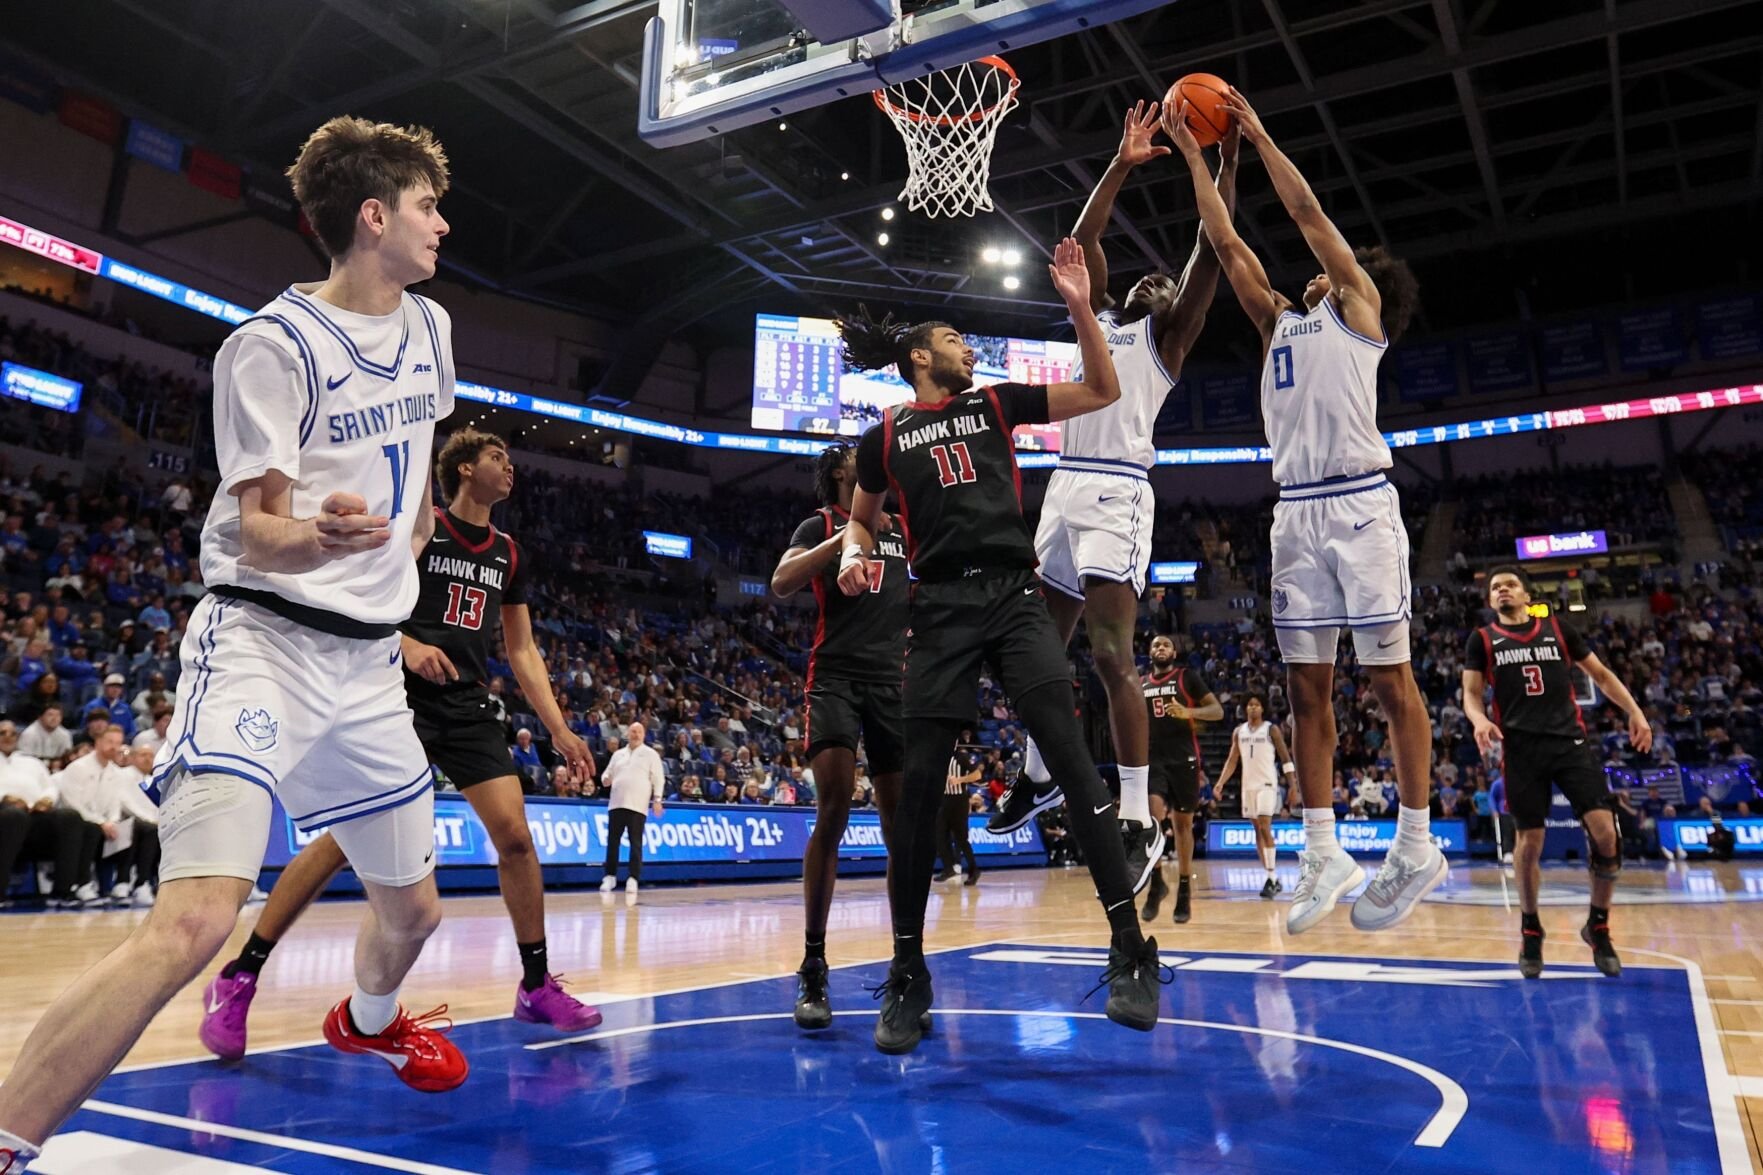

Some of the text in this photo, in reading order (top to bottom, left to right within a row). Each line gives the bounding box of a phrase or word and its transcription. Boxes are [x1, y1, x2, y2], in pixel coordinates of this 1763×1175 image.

[1108, 332, 1136, 346] OUIS
[1282, 319, 1322, 339] LOUIS
[1271, 344, 1295, 390] 0
[329, 393, 436, 443] SAINT LOUIS
[898, 413, 990, 453] HAWK HILL
[930, 441, 977, 488] 11
[1158, 450, 1189, 463] Enjoy
[1191, 448, 1258, 462] Responsibly
[381, 440, 410, 520] 11
[879, 541, 906, 559] HILL
[1526, 532, 1596, 554] us bank
[428, 554, 503, 590] HAWK HILL
[443, 581, 487, 631] 13
[1494, 646, 1562, 666] HAWK HILL
[1161, 685, 1177, 696] HILL
[1522, 664, 1545, 696] 3
[1152, 697, 1165, 718] 5
[530, 812, 783, 855] njoy Rponsibly 21+
[1225, 829, 1306, 845] BU LIG
[1340, 824, 1378, 839] Enjoy
[1340, 838, 1393, 852] Respon
